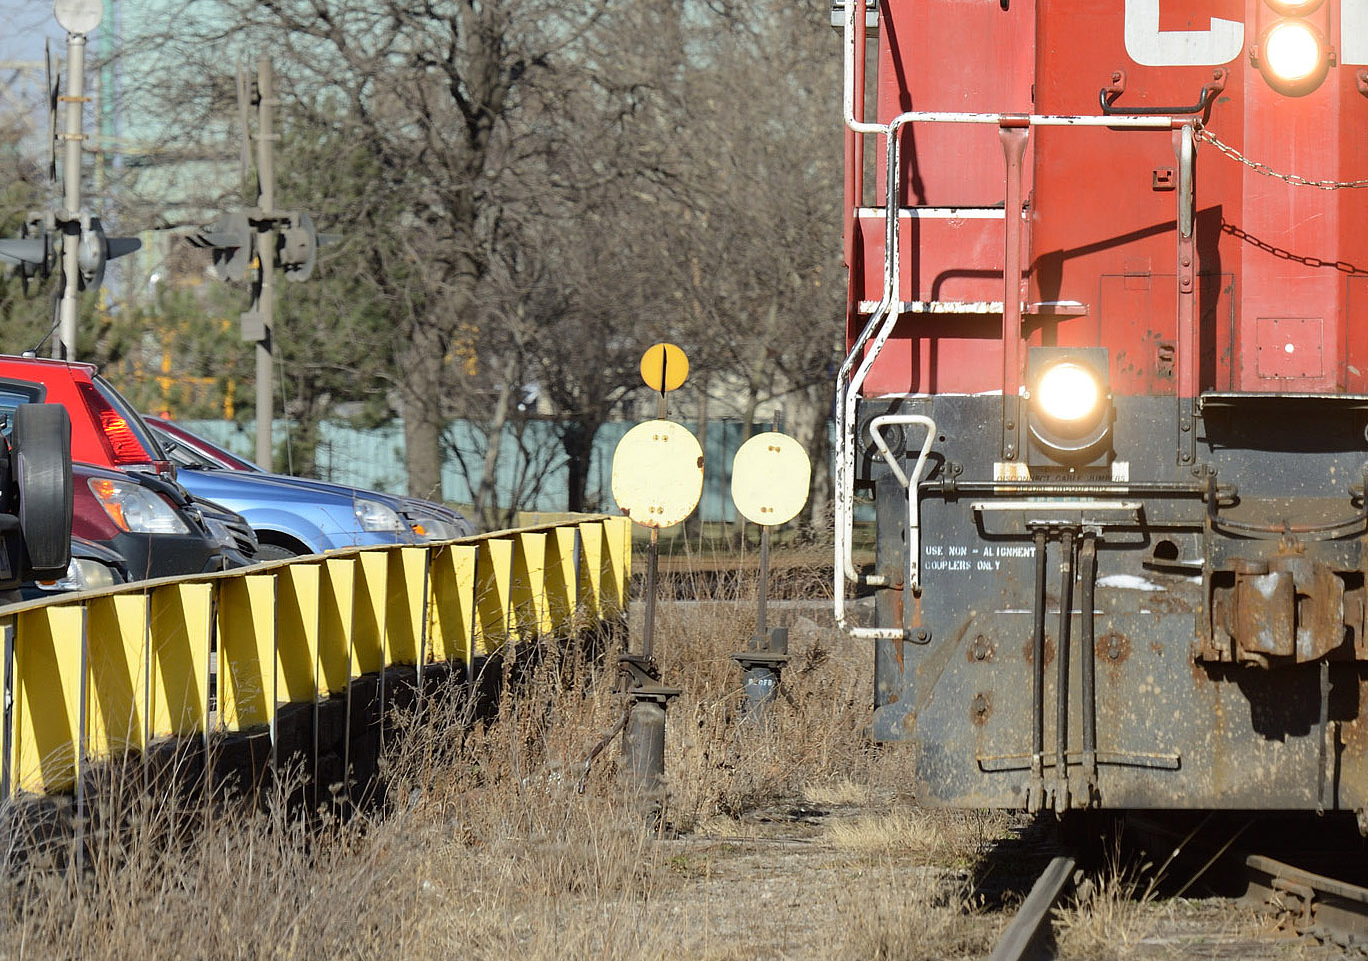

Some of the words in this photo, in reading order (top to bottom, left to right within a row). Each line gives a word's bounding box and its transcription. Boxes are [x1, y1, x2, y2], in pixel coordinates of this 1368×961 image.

[925, 546, 943, 556] USE
[948, 546, 967, 556] NON
[983, 546, 1036, 557] ALIGNMENT
[925, 560, 971, 571] COUPLERS
[977, 560, 1001, 571] ONLY
